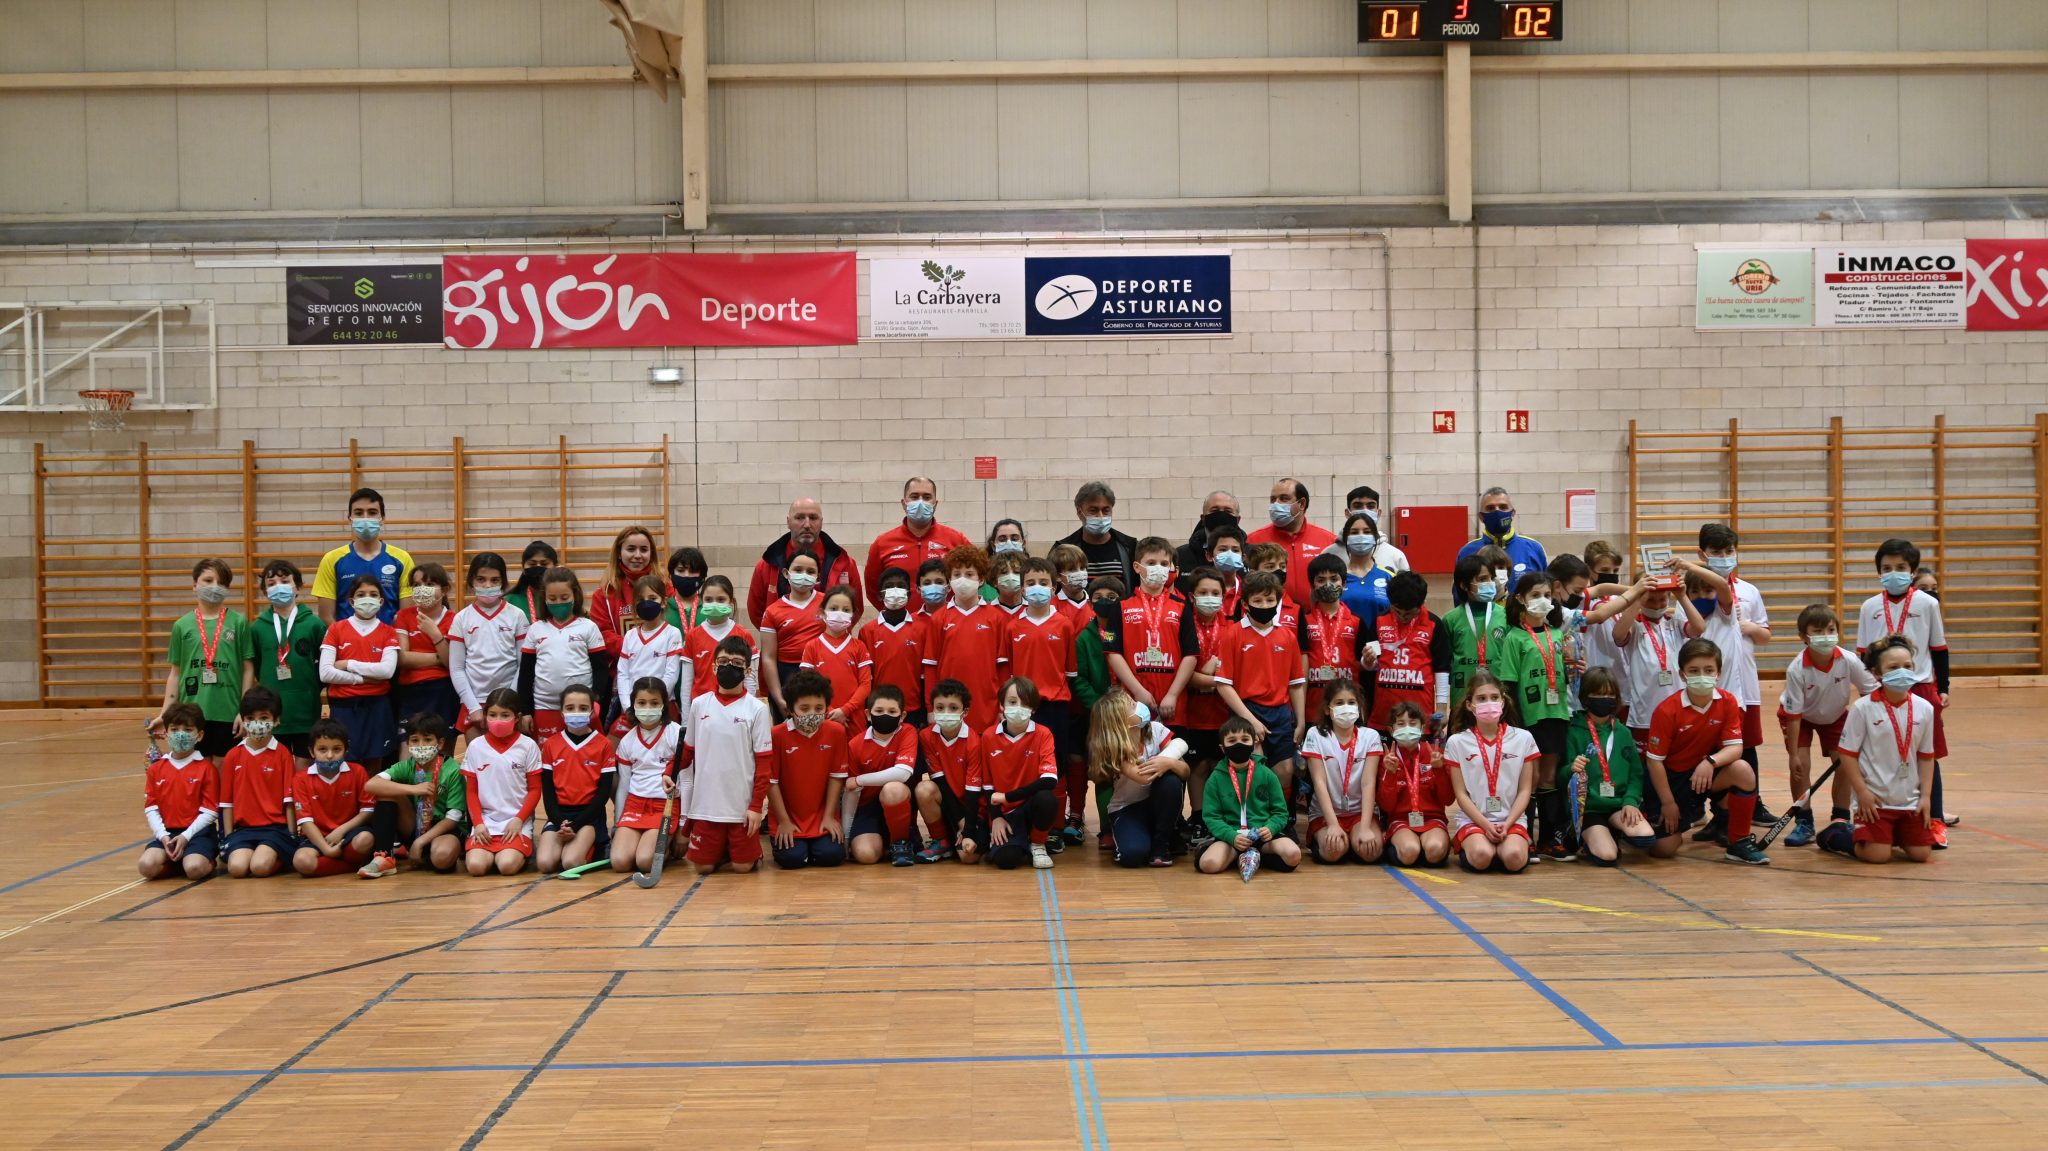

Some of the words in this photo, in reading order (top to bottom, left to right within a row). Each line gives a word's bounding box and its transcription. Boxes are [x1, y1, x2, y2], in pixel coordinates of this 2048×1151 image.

[1381, 9, 1418, 38] 01
[1514, 7, 1551, 36] 02
[1442, 23, 1480, 36] PERIODO
[1845, 272, 1948, 282] construcciones
[1102, 279, 1193, 294] DEPORTE
[443, 254, 670, 349] gijón
[895, 290, 911, 305] La
[917, 288, 1001, 307] Carbayera
[307, 303, 359, 314] SERVICIOS
[362, 301, 422, 312] INNOVACIÓN
[701, 297, 817, 330] Deporte
[1102, 299, 1222, 313] ASTURIANO
[307, 315, 422, 325] REFORMAS
[333, 331, 351, 340] 644
[354, 331, 367, 340] 92
[370, 330, 382, 340] 20
[385, 330, 398, 339] 46
[1392, 648, 1410, 665] 35
[1378, 668, 1424, 684] CODEMA
